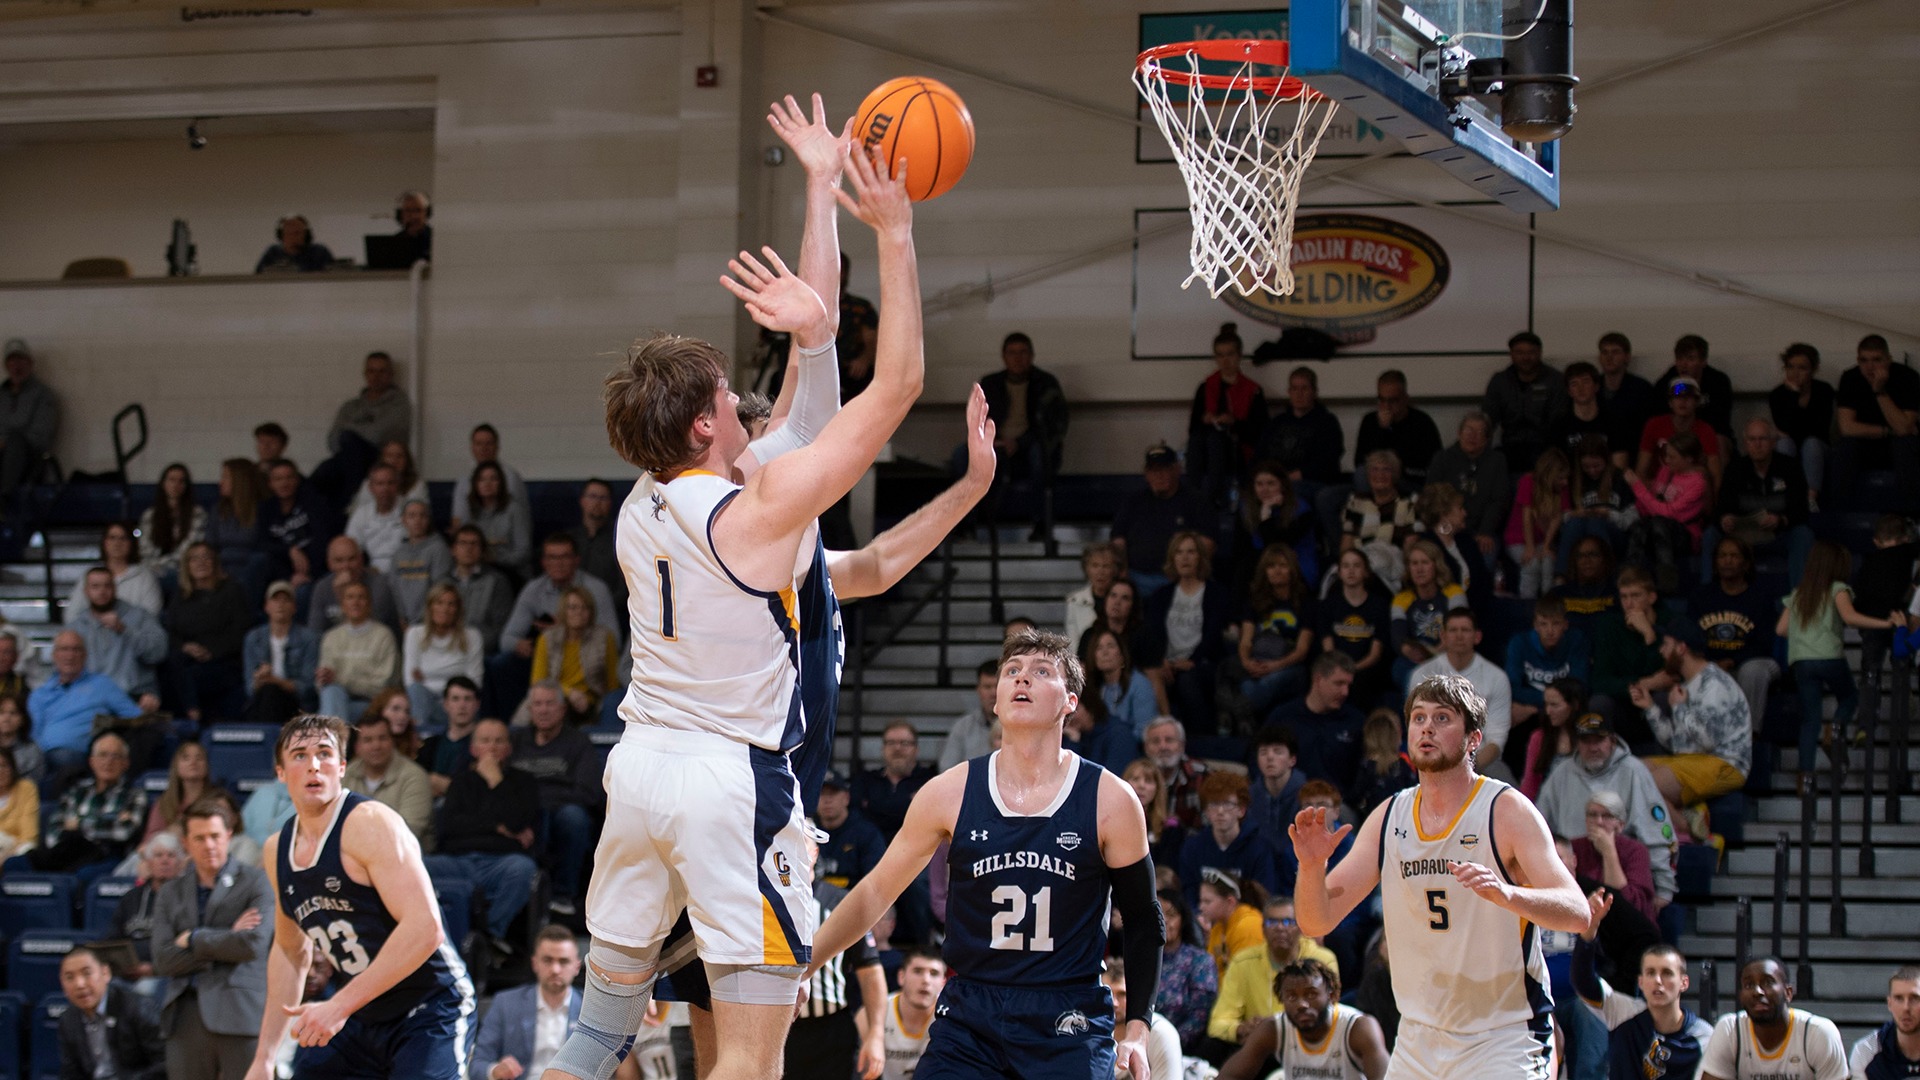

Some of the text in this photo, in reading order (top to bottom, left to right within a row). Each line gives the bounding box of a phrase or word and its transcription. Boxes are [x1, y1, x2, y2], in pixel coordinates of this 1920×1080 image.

[1350, 239, 1404, 273] BROS.
[655, 556, 678, 642] 1
[973, 851, 1076, 881] HILLSDALE
[990, 884, 1054, 952] 21
[1424, 888, 1452, 933] 5
